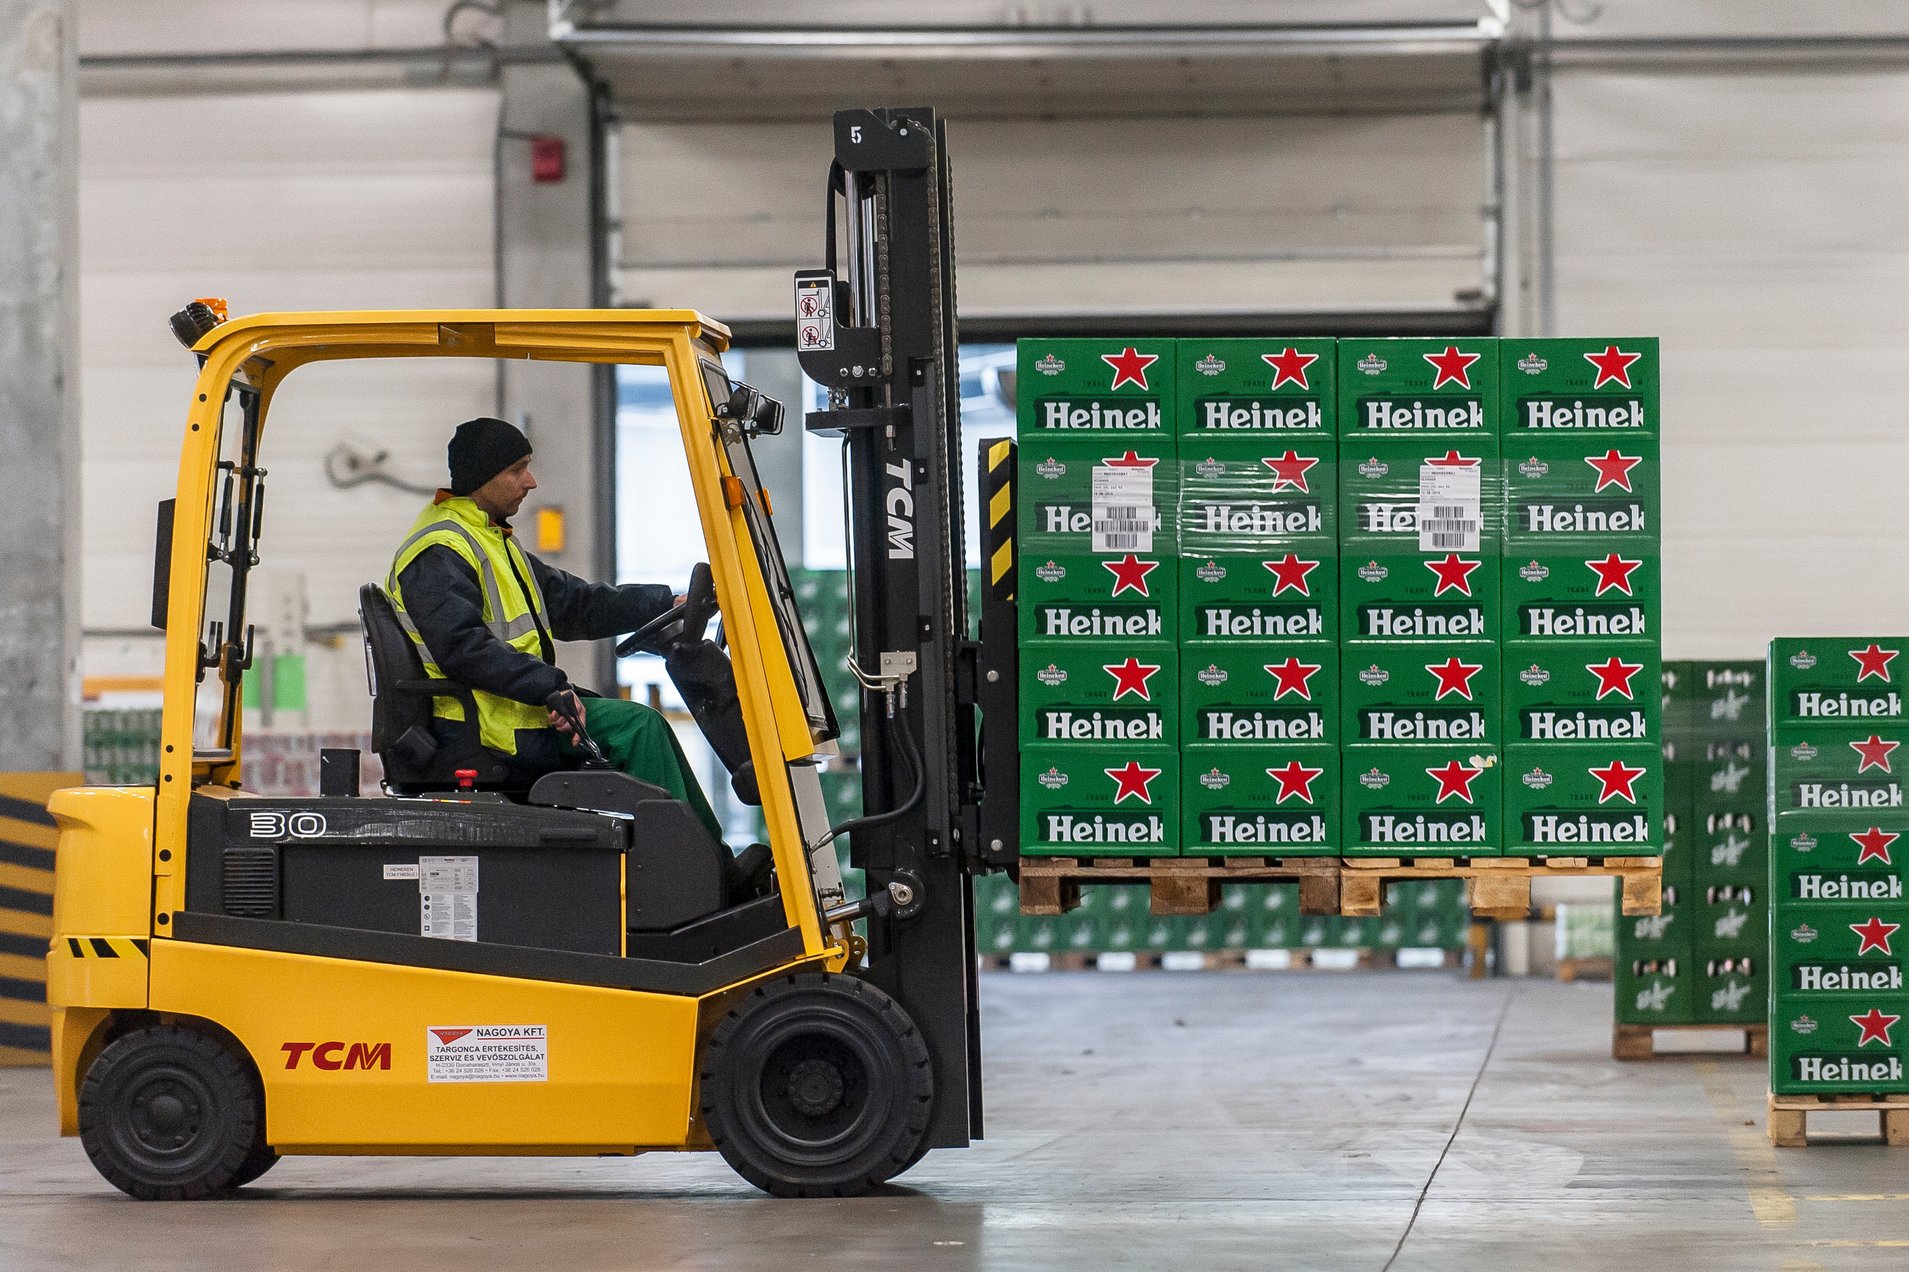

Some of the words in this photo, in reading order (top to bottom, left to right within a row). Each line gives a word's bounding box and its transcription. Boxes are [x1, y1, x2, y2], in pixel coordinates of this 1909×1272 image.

[851, 126, 862, 143] 5
[886, 458, 914, 559] TCM
[250, 812, 327, 838] 30
[477, 1029, 520, 1037] NAGOYA
[524, 1028, 544, 1036] KFT.
[280, 1041, 392, 1071] TCM
